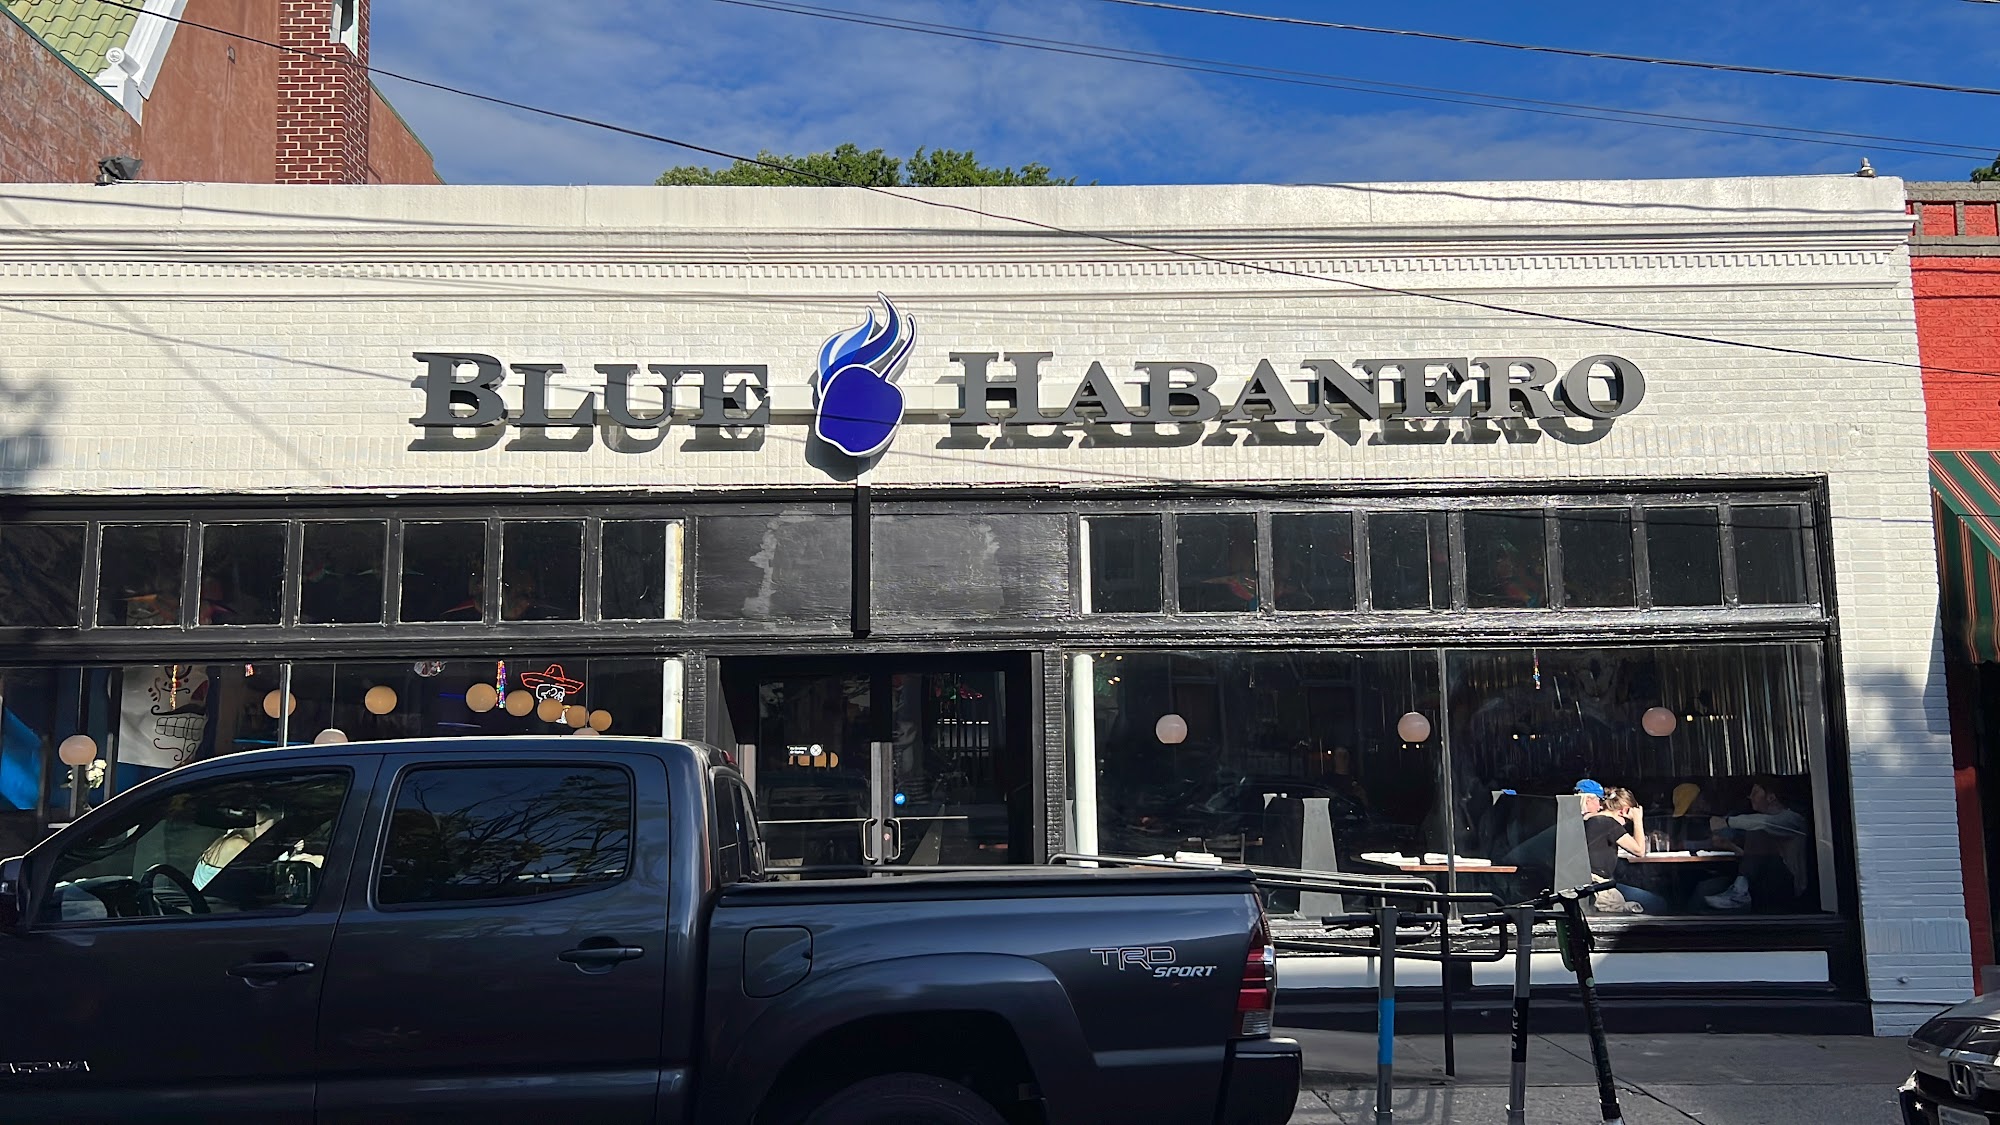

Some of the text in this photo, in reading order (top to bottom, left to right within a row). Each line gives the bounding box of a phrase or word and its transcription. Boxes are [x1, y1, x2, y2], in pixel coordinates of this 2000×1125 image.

[410, 350, 1646, 427] BLUE HABANERO
[1090, 946, 1177, 971] TRD
[1152, 965, 1218, 978] SPORT
